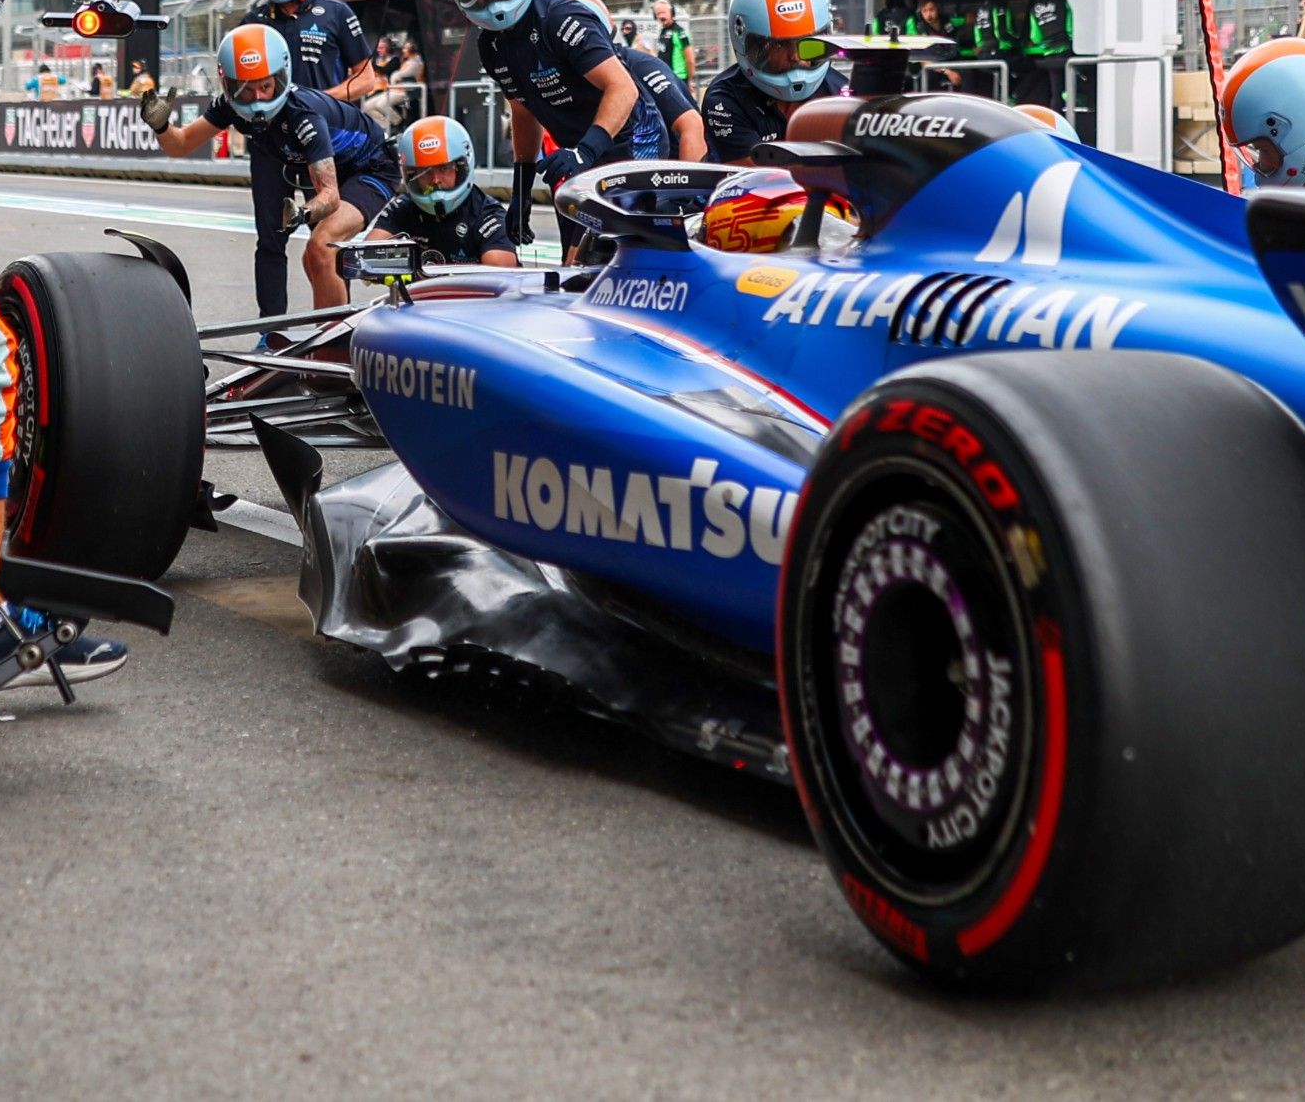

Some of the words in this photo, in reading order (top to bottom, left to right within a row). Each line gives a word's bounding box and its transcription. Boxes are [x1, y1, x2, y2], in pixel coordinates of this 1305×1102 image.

[777, 2, 804, 13] Gulf
[240, 54, 261, 64] Gulf
[855, 112, 968, 139] DURACELL
[419, 140, 439, 149] Gulf
[603, 175, 627, 188] KEEPER
[663, 173, 689, 185] airia
[747, 272, 786, 289] Carlos
[352, 346, 476, 411] MYPROTEIN
[875, 400, 1022, 511] ZERO
[493, 451, 801, 565] KOMATSU
